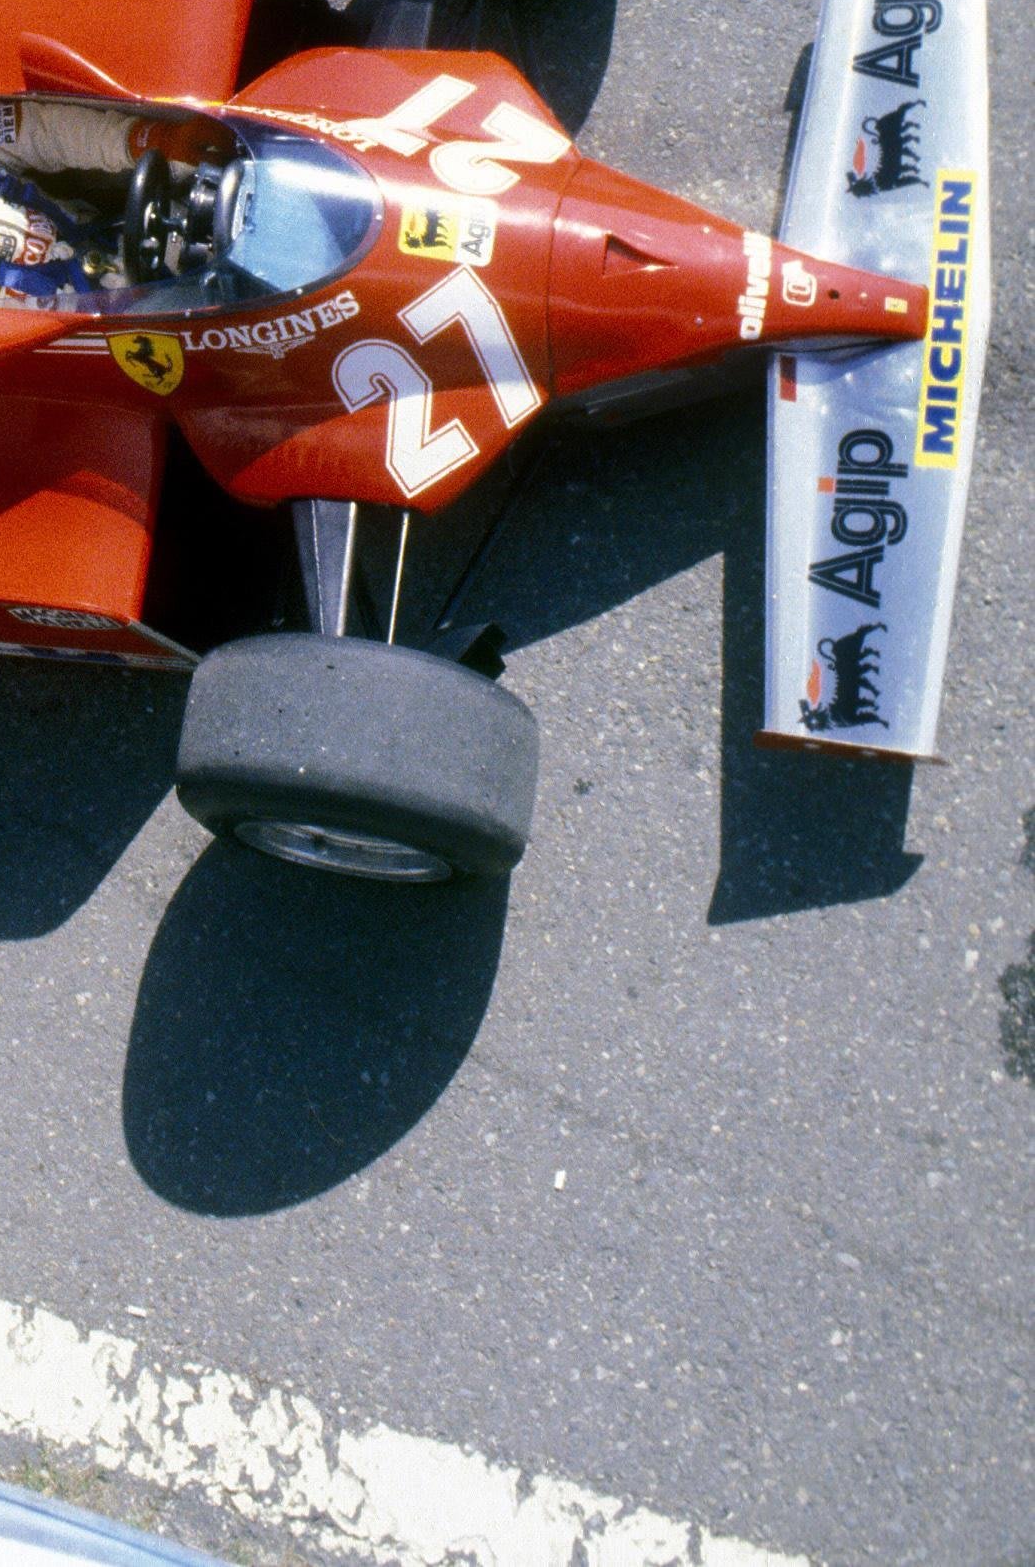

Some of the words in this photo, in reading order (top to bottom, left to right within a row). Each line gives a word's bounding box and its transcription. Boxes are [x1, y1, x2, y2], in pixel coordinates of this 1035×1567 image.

[183, 290, 361, 352] LONGINES
[331, 263, 542, 499] 27
[922, 179, 973, 456] MICHELIN
[808, 428, 909, 609] Agip
